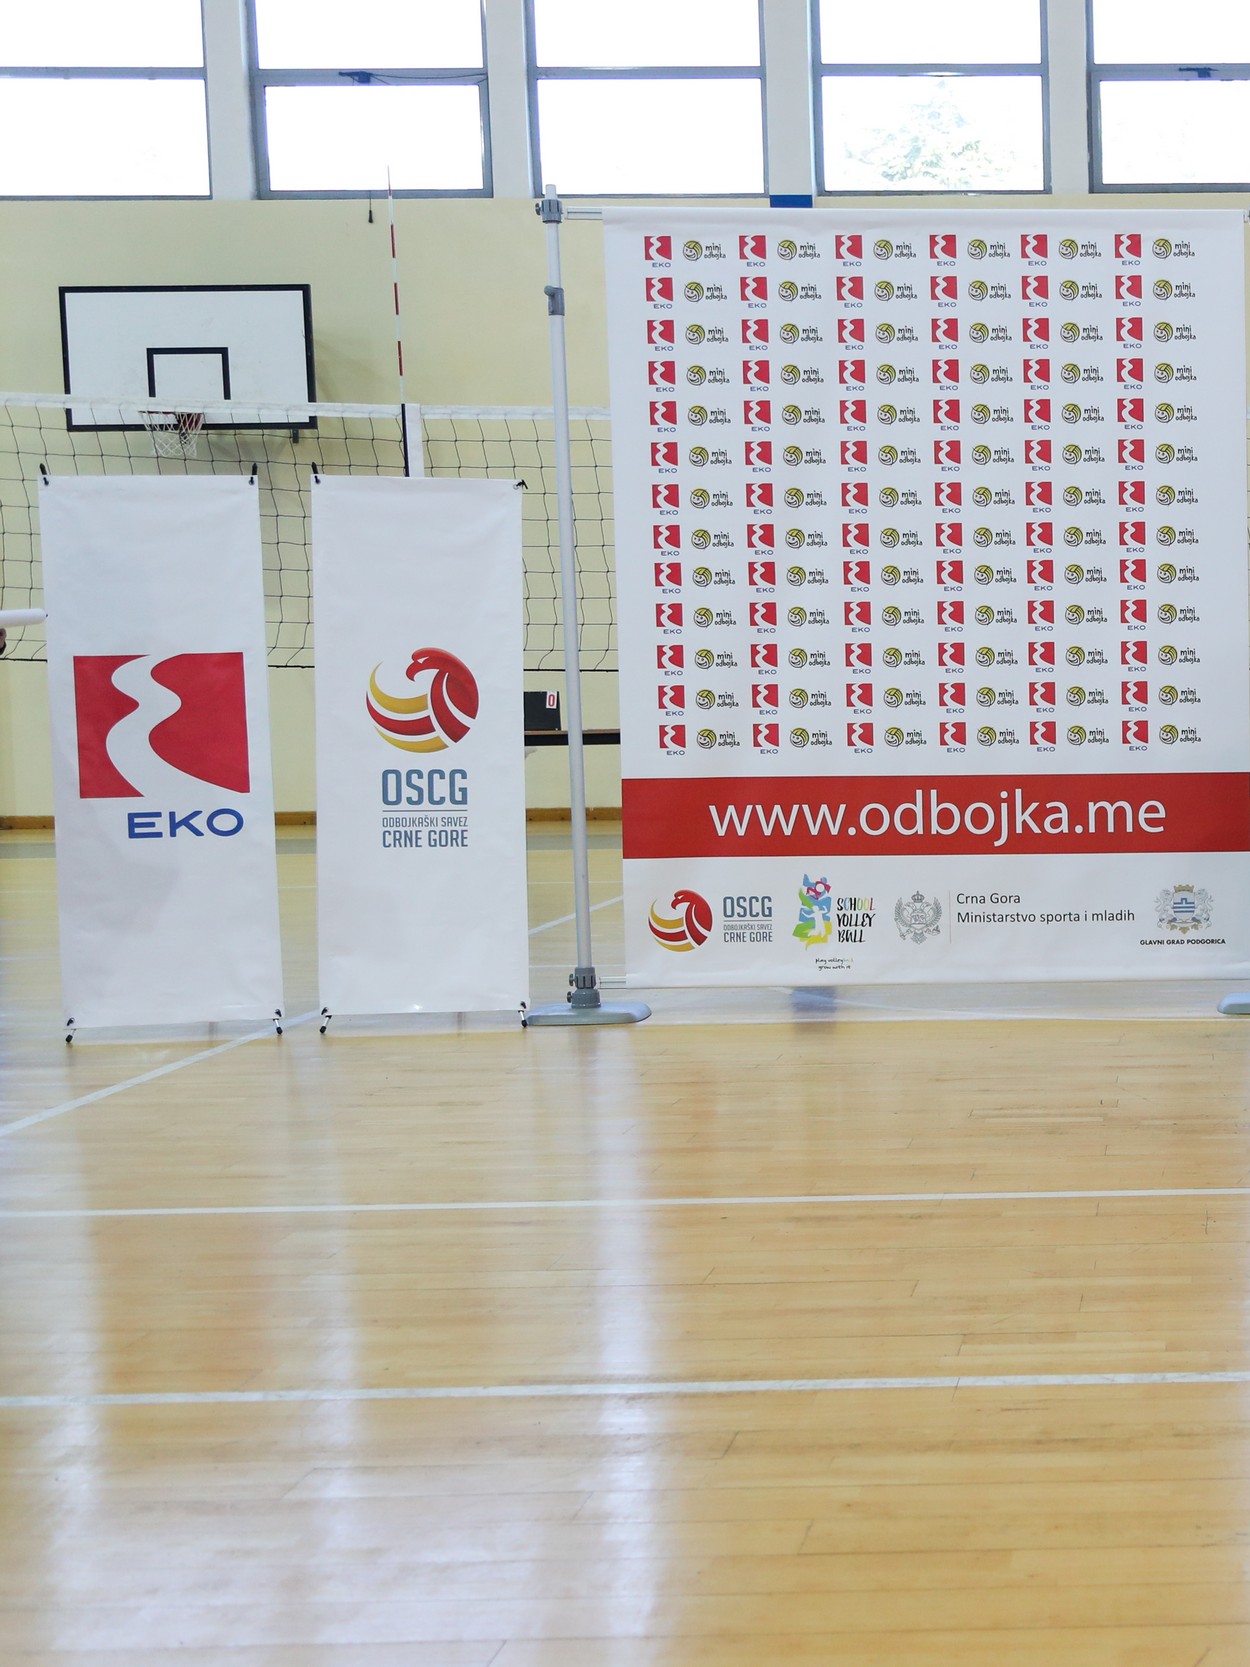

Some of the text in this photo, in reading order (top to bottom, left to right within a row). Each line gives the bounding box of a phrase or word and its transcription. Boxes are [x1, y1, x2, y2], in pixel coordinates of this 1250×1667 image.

[705, 243, 722, 252] mini
[704, 251, 727, 260] odbojka
[651, 261, 672, 269] EKO
[896, 283, 912, 292] mini
[896, 291, 918, 300] odbojka
[707, 326, 724, 335] mini
[1082, 325, 1098, 334] mini
[706, 334, 729, 344] odbojka
[1080, 333, 1104, 342] odbojka
[802, 367, 820, 376] mini
[802, 375, 825, 384] odbojka
[992, 406, 1010, 415] mini
[992, 414, 1014, 424] odbojka
[940, 424, 960, 432] EKO
[711, 449, 728, 458] mini
[1177, 446, 1194, 455] mini
[710, 457, 733, 466] odbojka
[1176, 454, 1199, 464] odbojka
[901, 489, 918, 498] mini
[900, 497, 923, 506] odbojka
[1085, 529, 1102, 538] mini
[1084, 537, 1107, 546] odbojka
[714, 569, 730, 578] mini
[1178, 566, 1194, 575] mini
[712, 577, 736, 586] odbojka
[1178, 574, 1200, 582] odbojka
[661, 587, 682, 595] EKO
[996, 608, 1012, 617] mini
[996, 616, 1018, 624] odbojka
[716, 651, 734, 660] mini
[1179, 647, 1196, 656] mini
[716, 659, 738, 668] odbojka
[1178, 655, 1201, 664] odbojka
[1127, 665, 1147, 673] EKO
[810, 690, 826, 699] mini
[810, 698, 832, 708] odbojka
[1088, 728, 1104, 737] mini
[1088, 736, 1110, 744] odbojka
[382, 768, 468, 806] OSCG
[382, 814, 468, 828] ODBOJKAŠKI SAVEZ
[708, 788, 1166, 847] www.odbojka.me
[128, 808, 244, 839] EKO
[382, 829, 468, 848] CRNE GORE
[956, 892, 1021, 905] Crna Gora
[723, 896, 772, 918] OSCG
[837, 896, 875, 912] SCHOOL
[836, 913, 876, 928] VOLLEY
[957, 910, 1135, 925] Ministarstvo sporta i mladih
[724, 932, 773, 943] CRNE GORE
